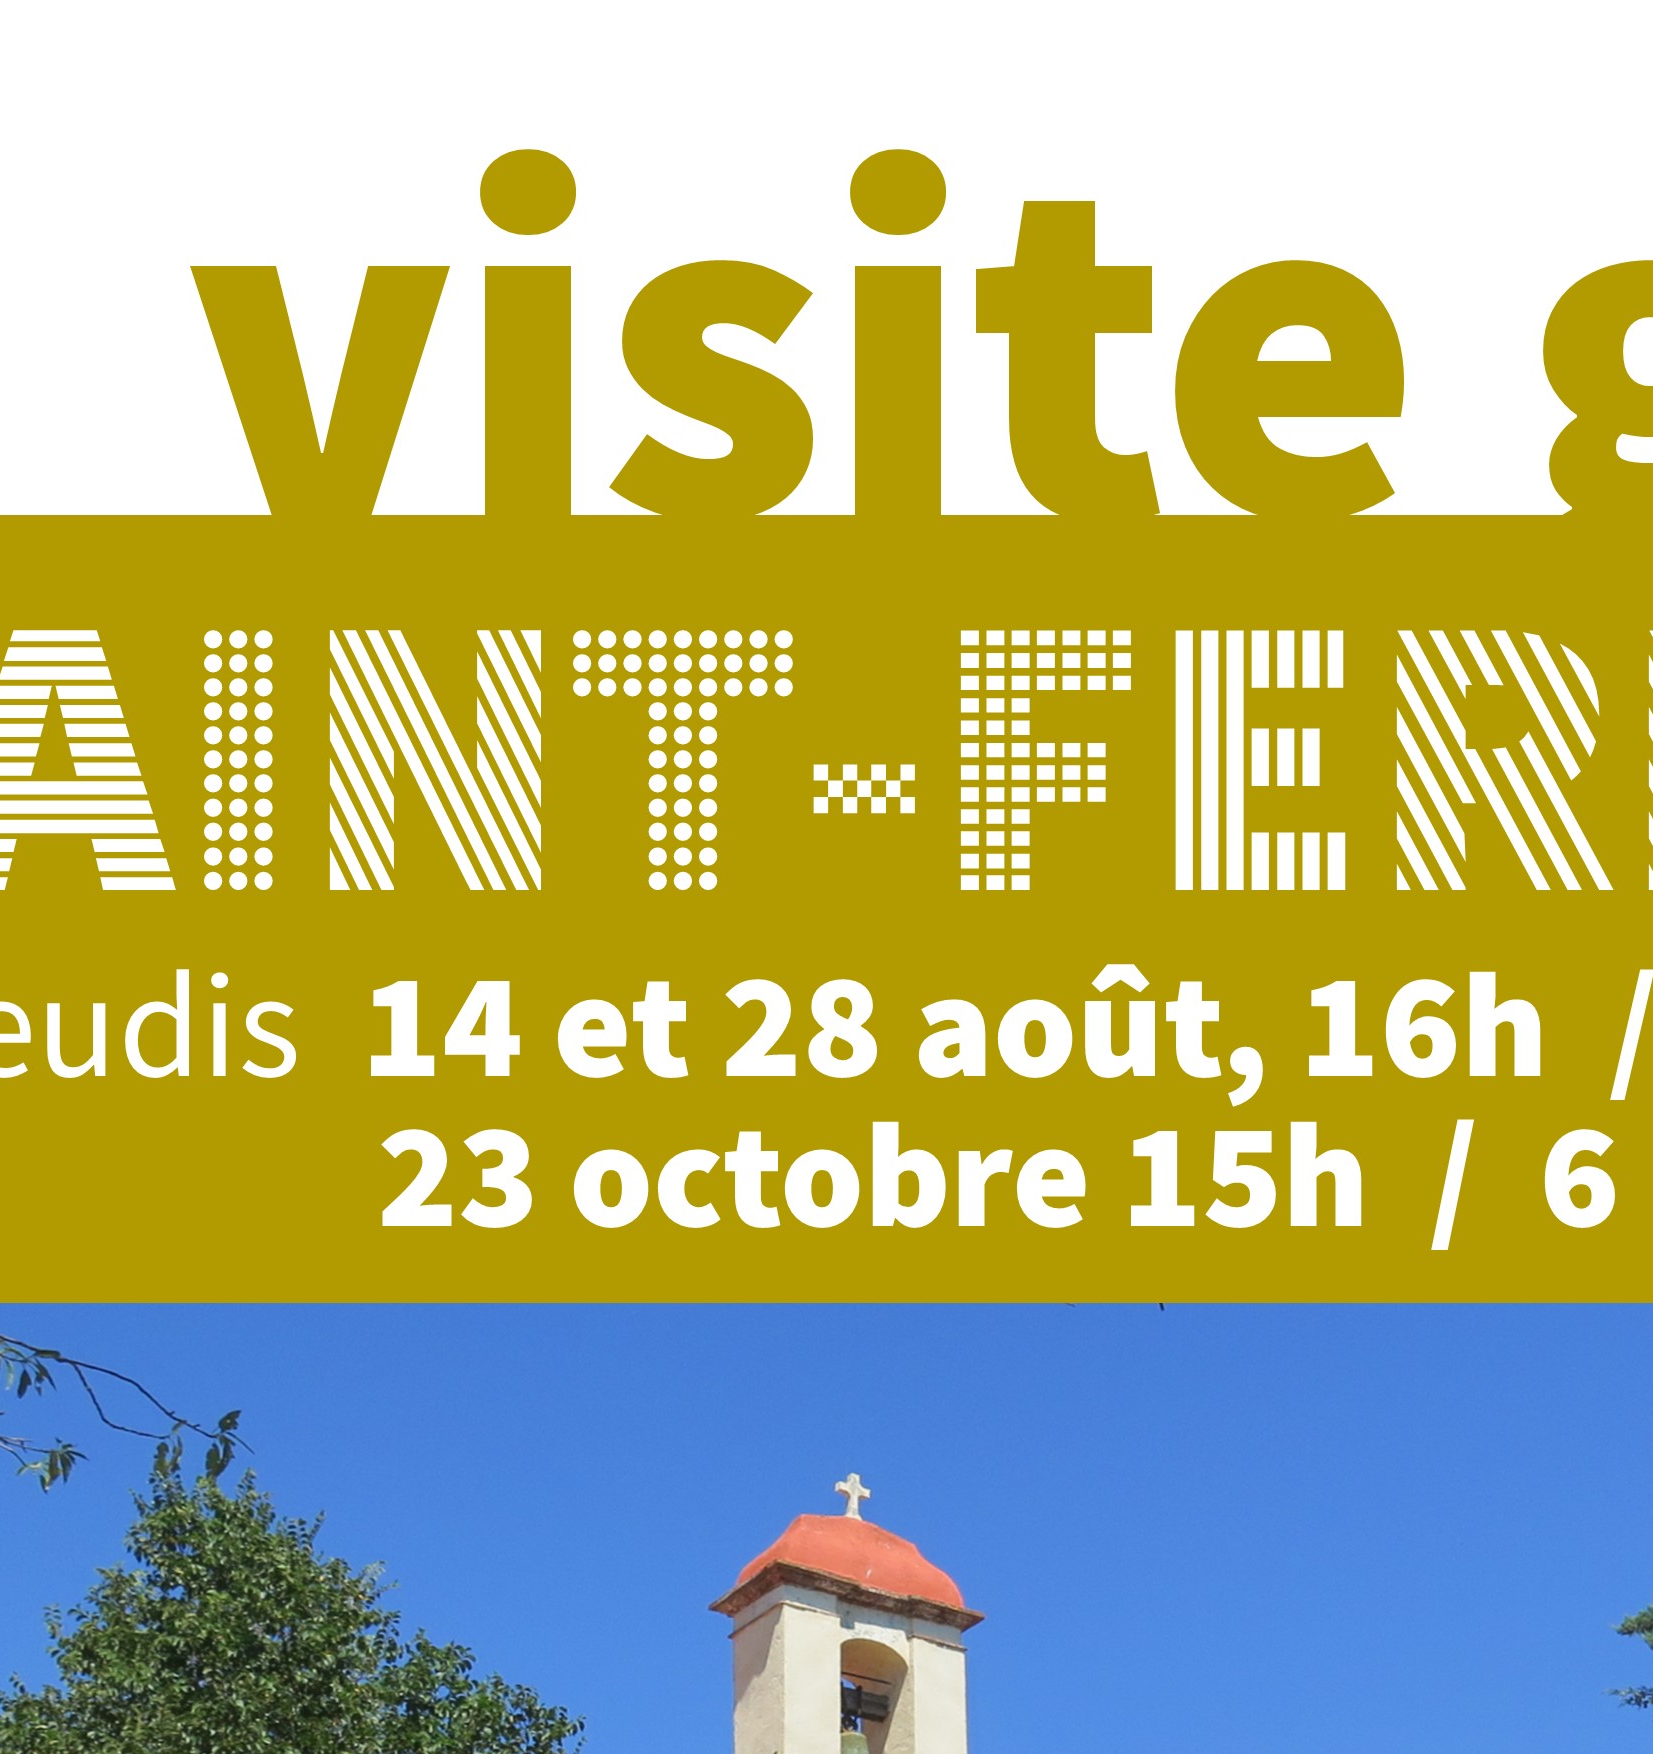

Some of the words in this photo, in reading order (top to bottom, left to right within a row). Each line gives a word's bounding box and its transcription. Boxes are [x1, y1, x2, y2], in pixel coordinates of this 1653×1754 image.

[191, 148, 1407, 516] visite
[371, 981, 520, 1076] 14
[558, 981, 688, 1078] et
[726, 979, 877, 1078] 28
[919, 964, 1263, 1107] août,
[1309, 972, 1540, 1078] 16h
[381, 1129, 532, 1228] 23
[574, 1122, 1086, 1228] octobre
[1131, 1122, 1362, 1228] 15h
[1545, 1129, 1615, 1228] 6
